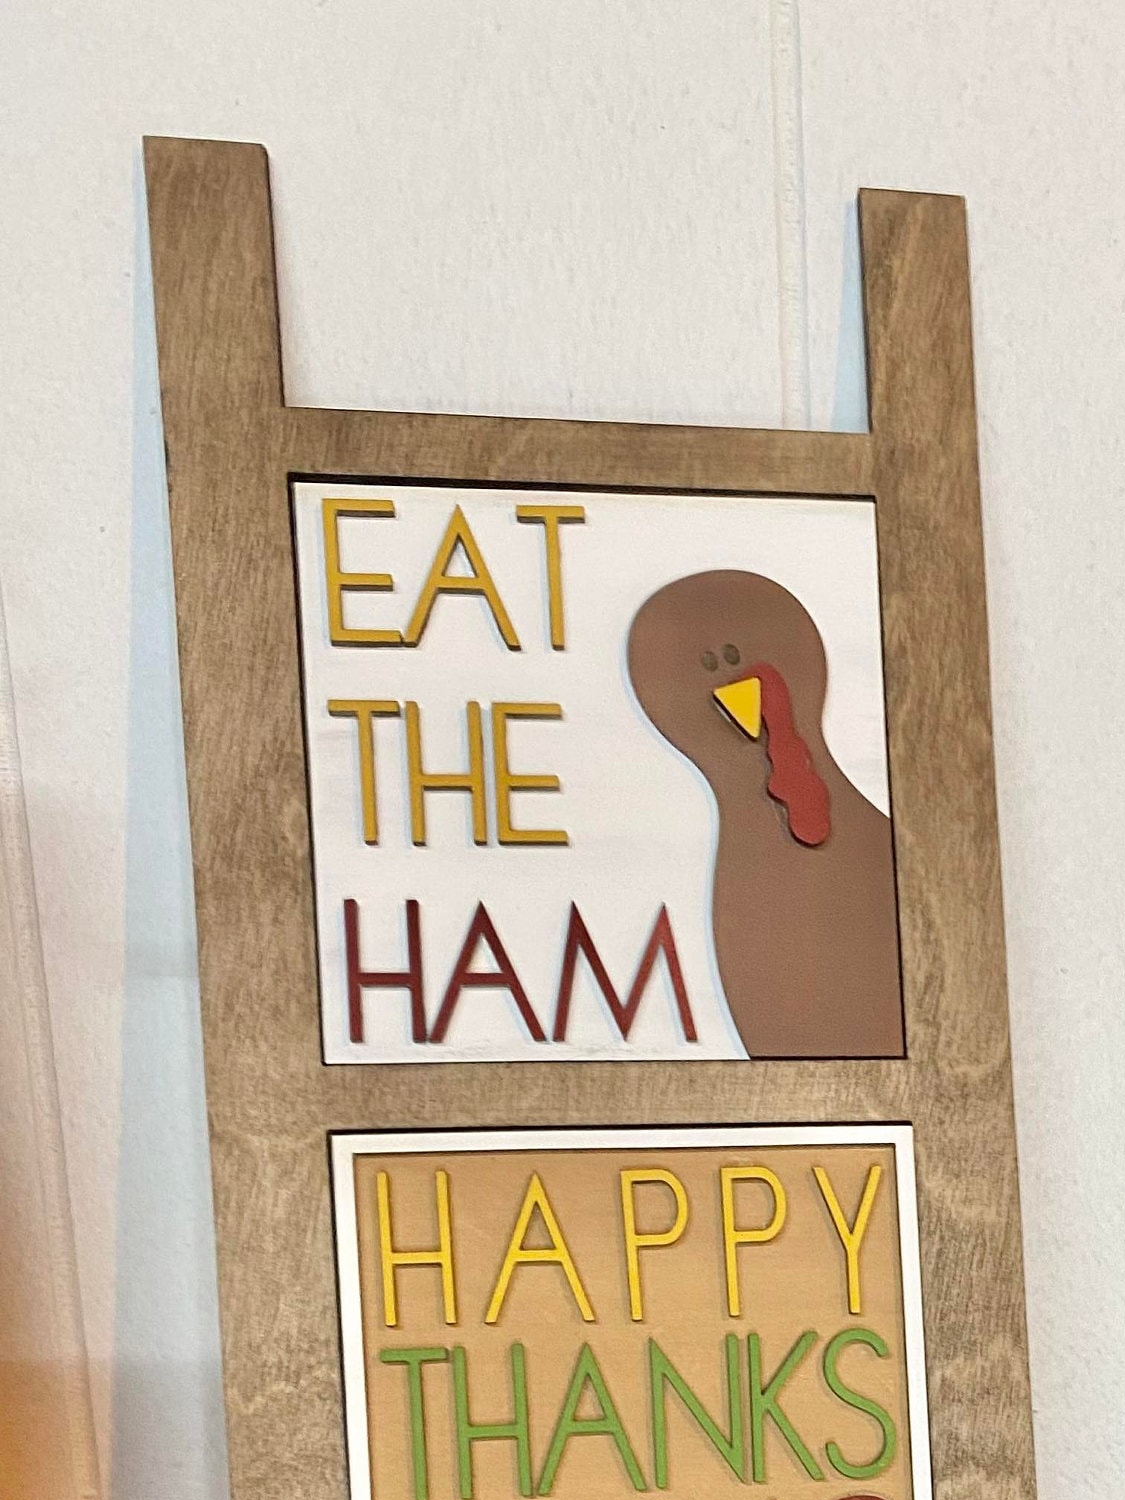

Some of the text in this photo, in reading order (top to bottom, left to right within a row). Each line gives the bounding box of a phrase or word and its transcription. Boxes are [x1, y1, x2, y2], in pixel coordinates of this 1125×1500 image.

[322, 498, 586, 651] EAT
[328, 699, 569, 846] THE
[343, 898, 698, 1043] HAM
[377, 1165, 882, 1327] HAPPY
